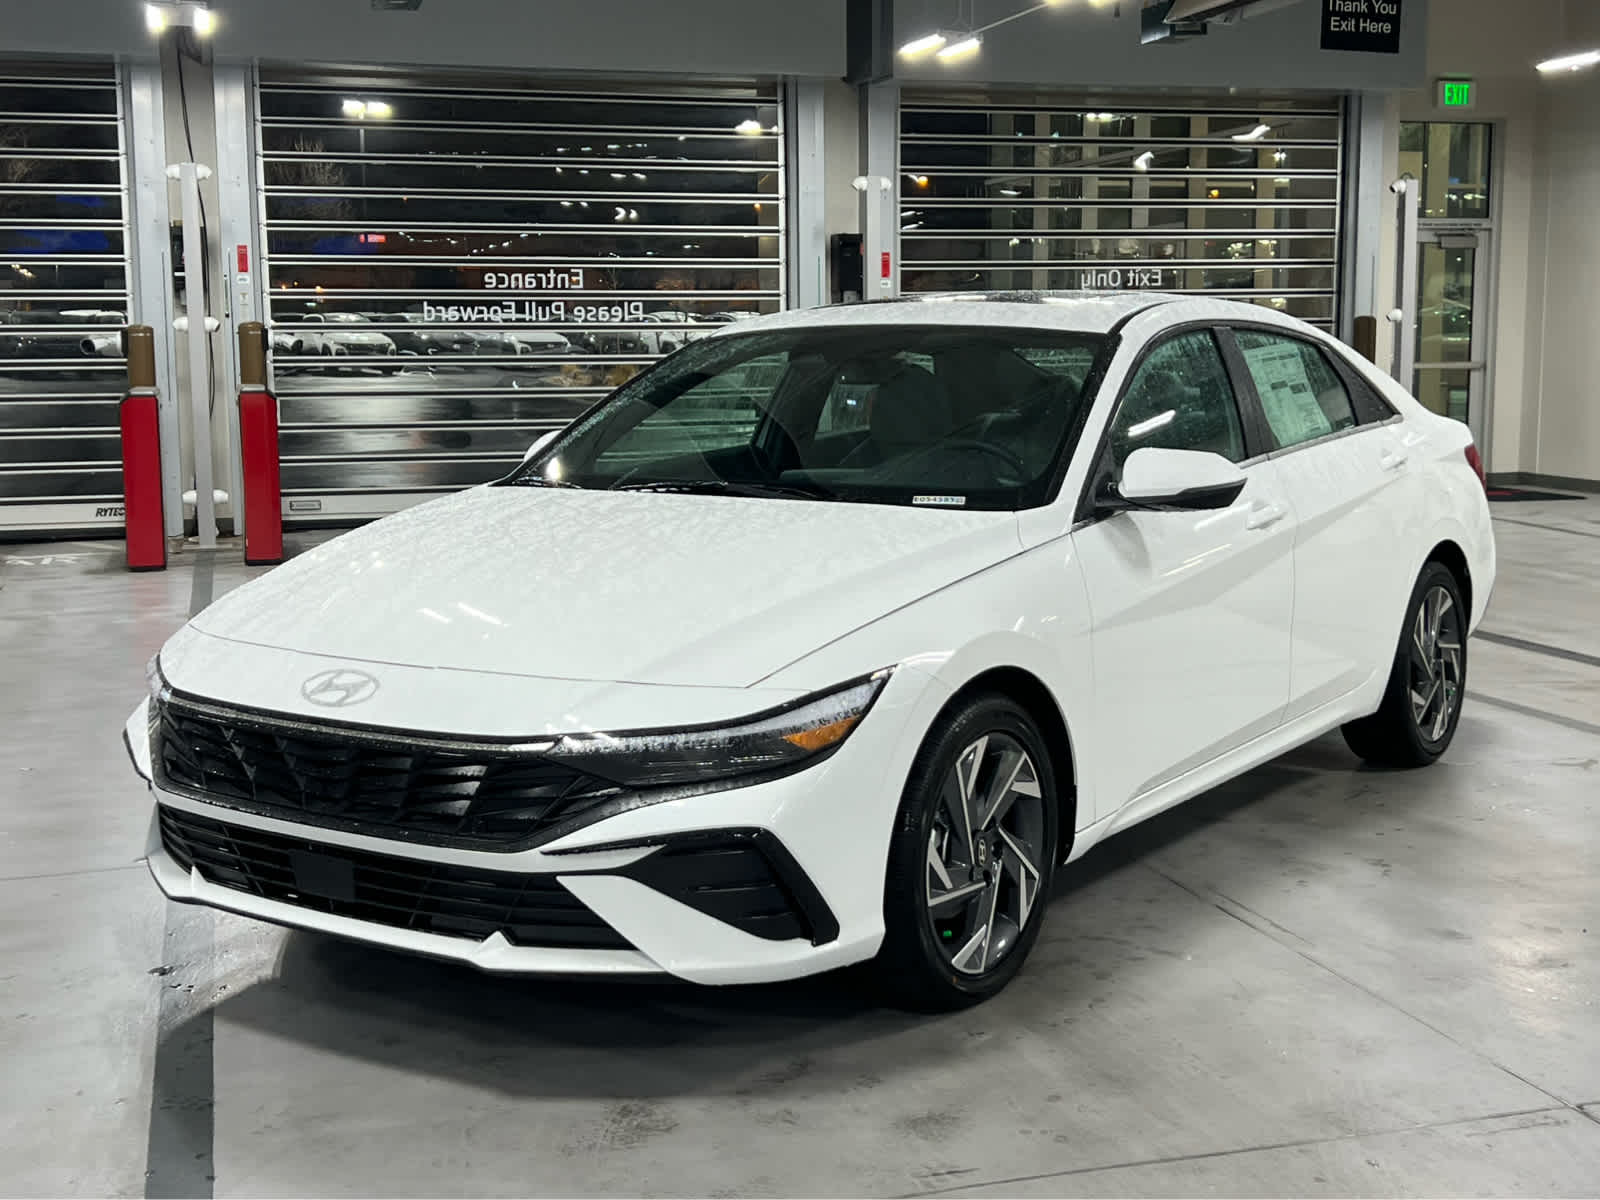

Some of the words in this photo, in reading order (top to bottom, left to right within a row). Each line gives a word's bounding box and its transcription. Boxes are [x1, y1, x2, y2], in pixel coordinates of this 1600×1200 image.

[1327, 0, 1369, 13] Thank
[1371, 0, 1397, 15] You
[1330, 16, 1356, 32] Exit
[1359, 18, 1392, 34] Here
[1444, 83, 1471, 105] EXIT
[95, 507, 127, 517] RYTEC
